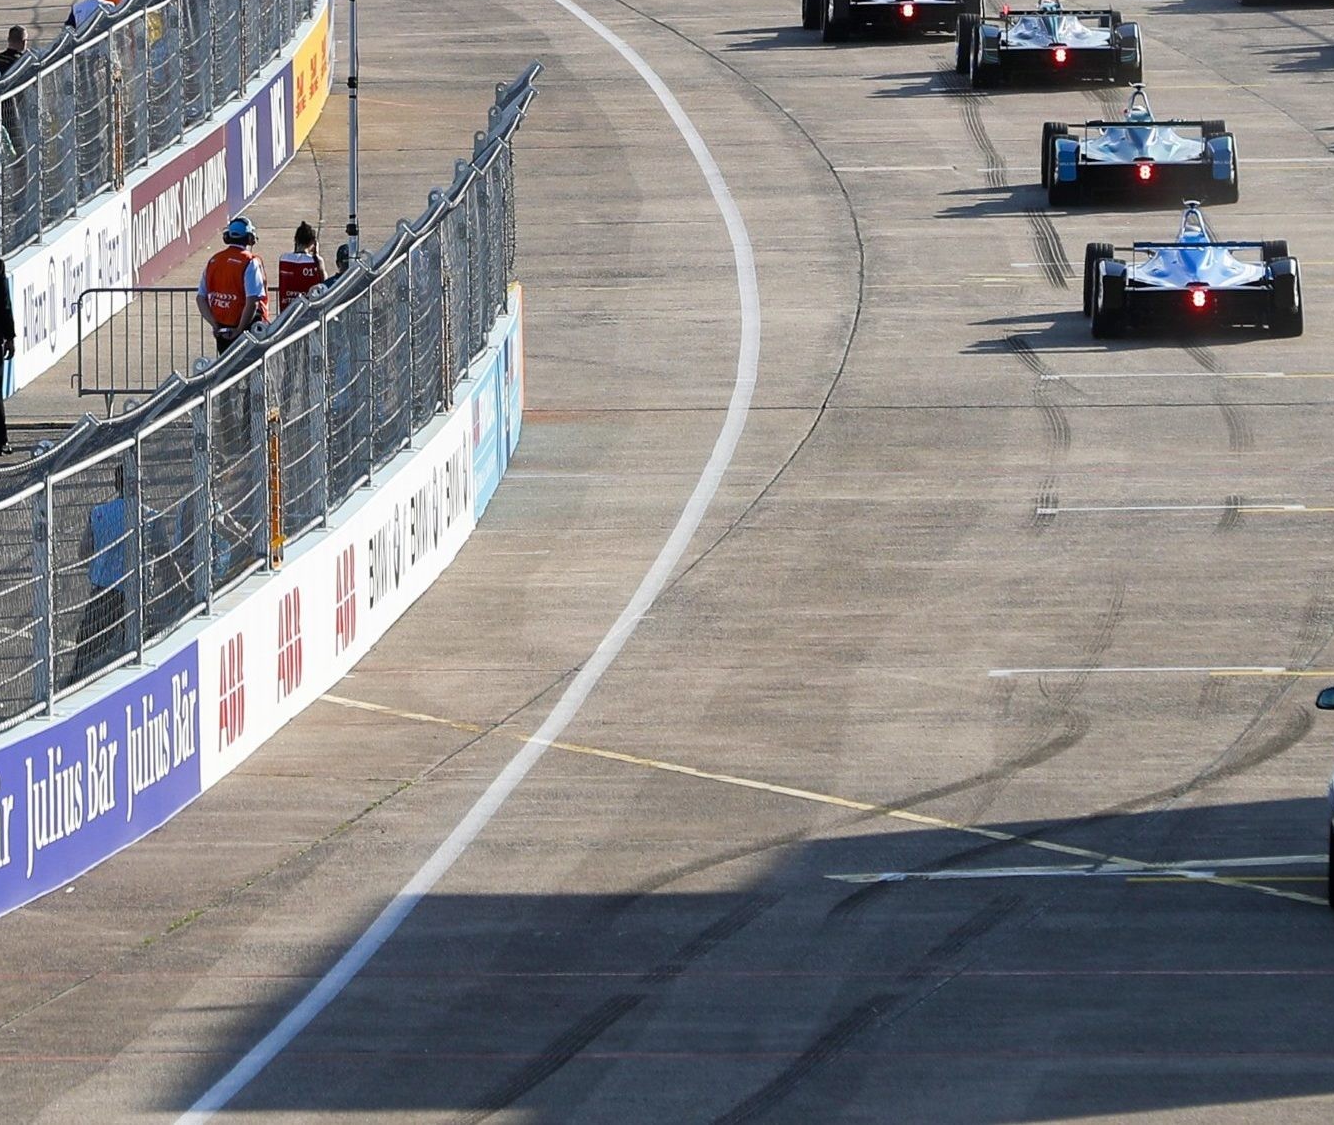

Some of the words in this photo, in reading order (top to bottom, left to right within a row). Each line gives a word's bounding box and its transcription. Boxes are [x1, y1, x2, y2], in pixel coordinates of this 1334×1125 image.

[23, 282, 48, 355] Allianz
[277, 586, 303, 703] ABB
[335, 542, 356, 656] ABB
[126, 694, 170, 823] Julius
[171, 669, 198, 773] Bär
[218, 632, 245, 752] ABB
[25, 748, 84, 879] Julius
[86, 722, 118, 823] Bär
